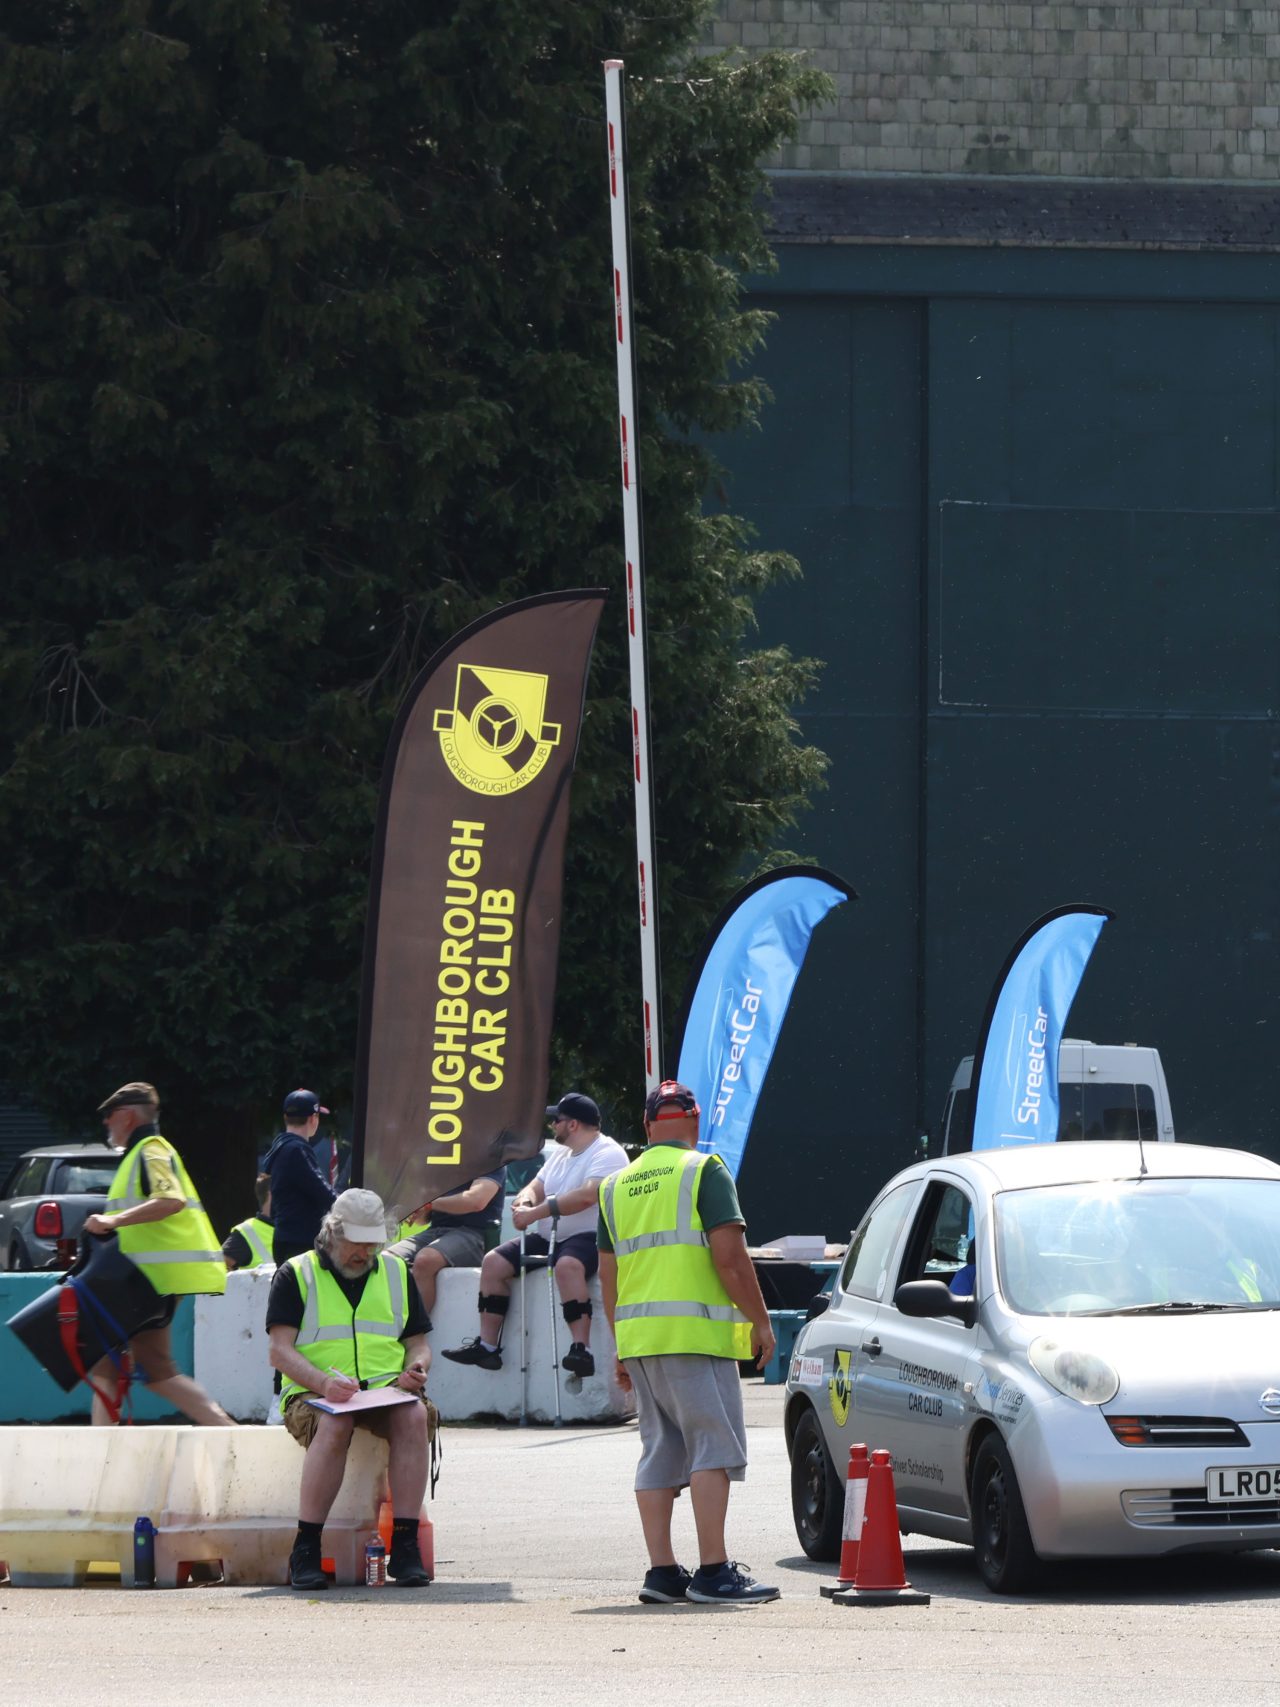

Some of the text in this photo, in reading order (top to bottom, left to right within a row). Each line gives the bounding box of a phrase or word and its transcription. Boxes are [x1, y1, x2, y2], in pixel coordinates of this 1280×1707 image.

[443, 737, 548, 793] LOUGHBOROUGH CAR CLUB
[427, 820, 485, 1165] LOUGHBOROUGH
[469, 889, 516, 1092] CAR CLUB
[1018, 1006, 1048, 1125] StreetCar
[622, 1166, 675, 1184] LOUGHBOROUGH
[628, 1186, 642, 1197] CAR
[898, 1362, 959, 1393] LOUGHBOROUGH
[908, 1391, 923, 1415] CAR
[923, 1395, 943, 1417] CLUB
[907, 1458, 944, 1485] Scholarship
